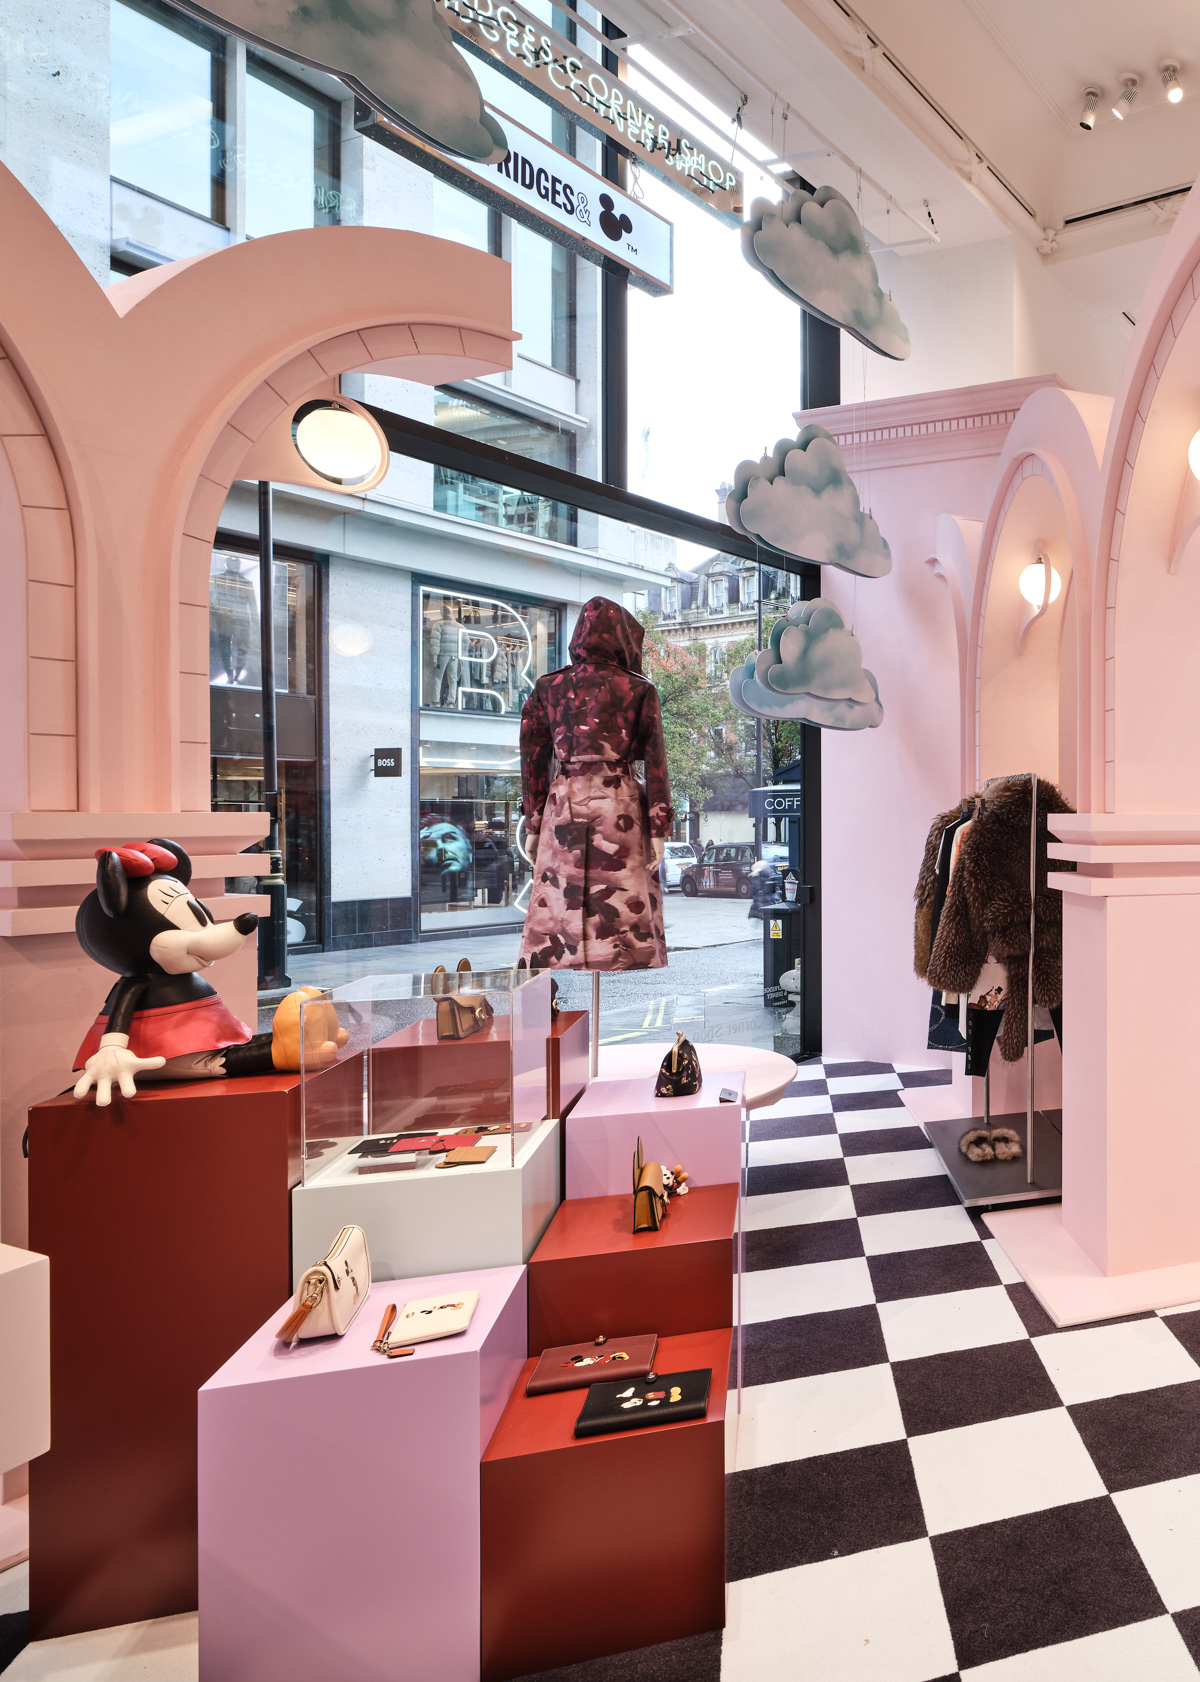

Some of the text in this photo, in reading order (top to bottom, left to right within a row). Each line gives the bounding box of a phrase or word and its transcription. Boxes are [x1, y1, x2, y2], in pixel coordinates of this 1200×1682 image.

[560, 57, 669, 148] CORNER
[677, 139, 736, 192] SHOP
[378, 758, 395, 767] BOSS
[764, 797, 801, 810] COFF
